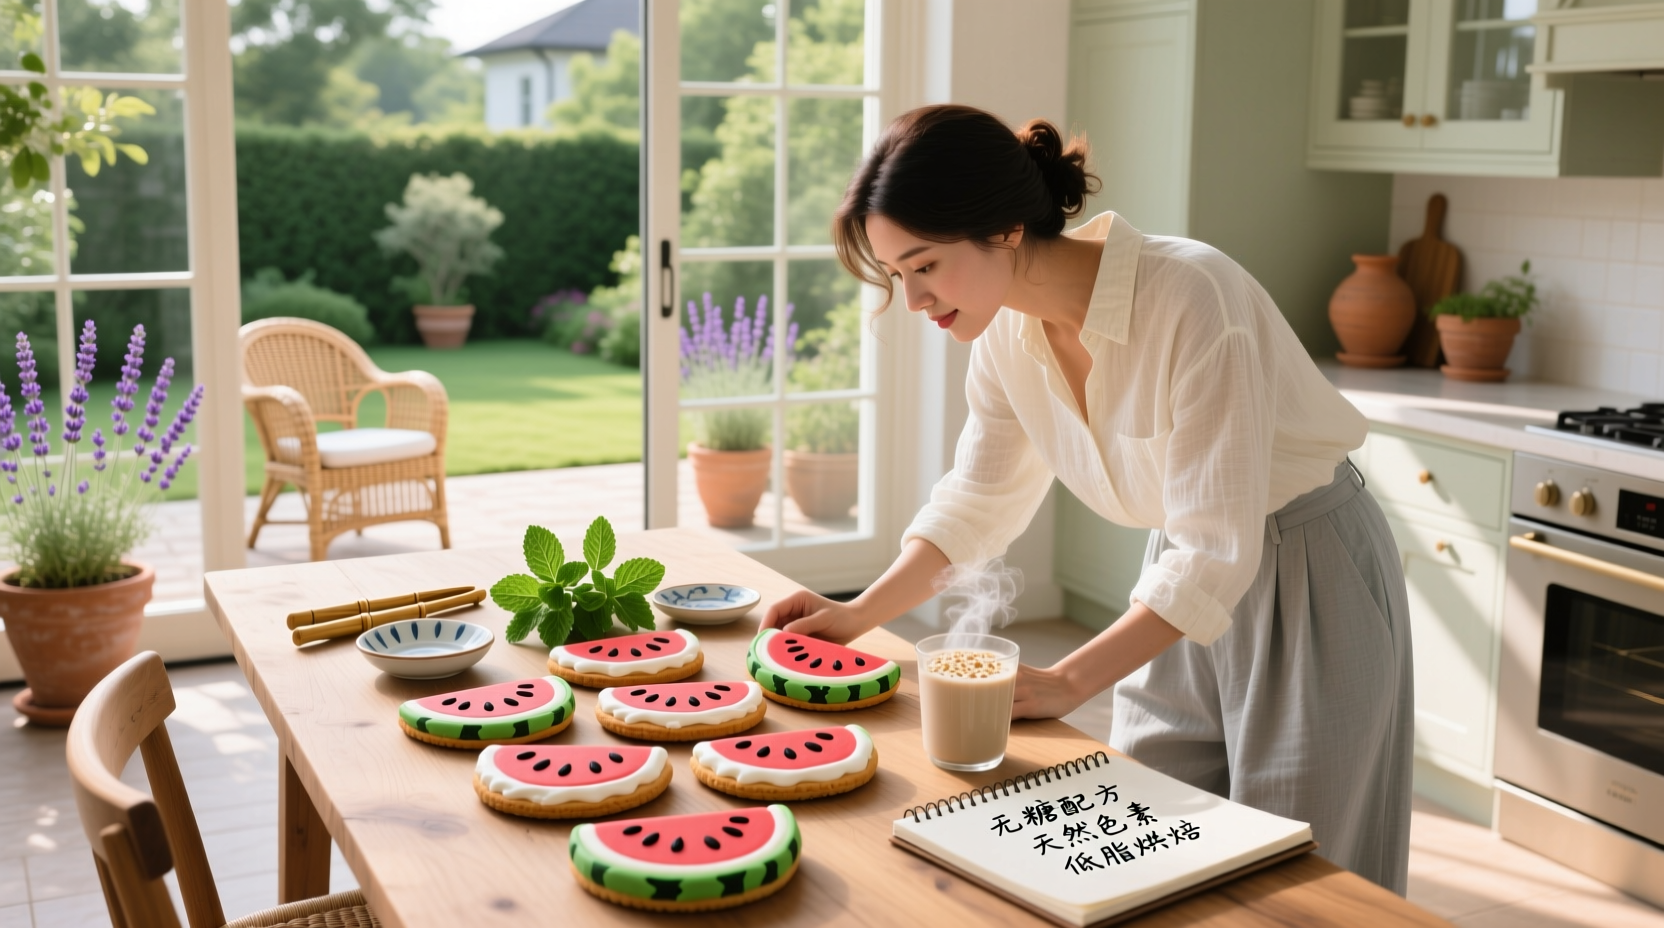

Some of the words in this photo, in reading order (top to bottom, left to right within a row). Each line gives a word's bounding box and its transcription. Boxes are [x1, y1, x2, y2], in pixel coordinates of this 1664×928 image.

[990, 784, 1119, 837] 无糖配方
[1033, 801, 1158, 856] 天然色素
[1064, 819, 1201, 875] 低脂烘焙
